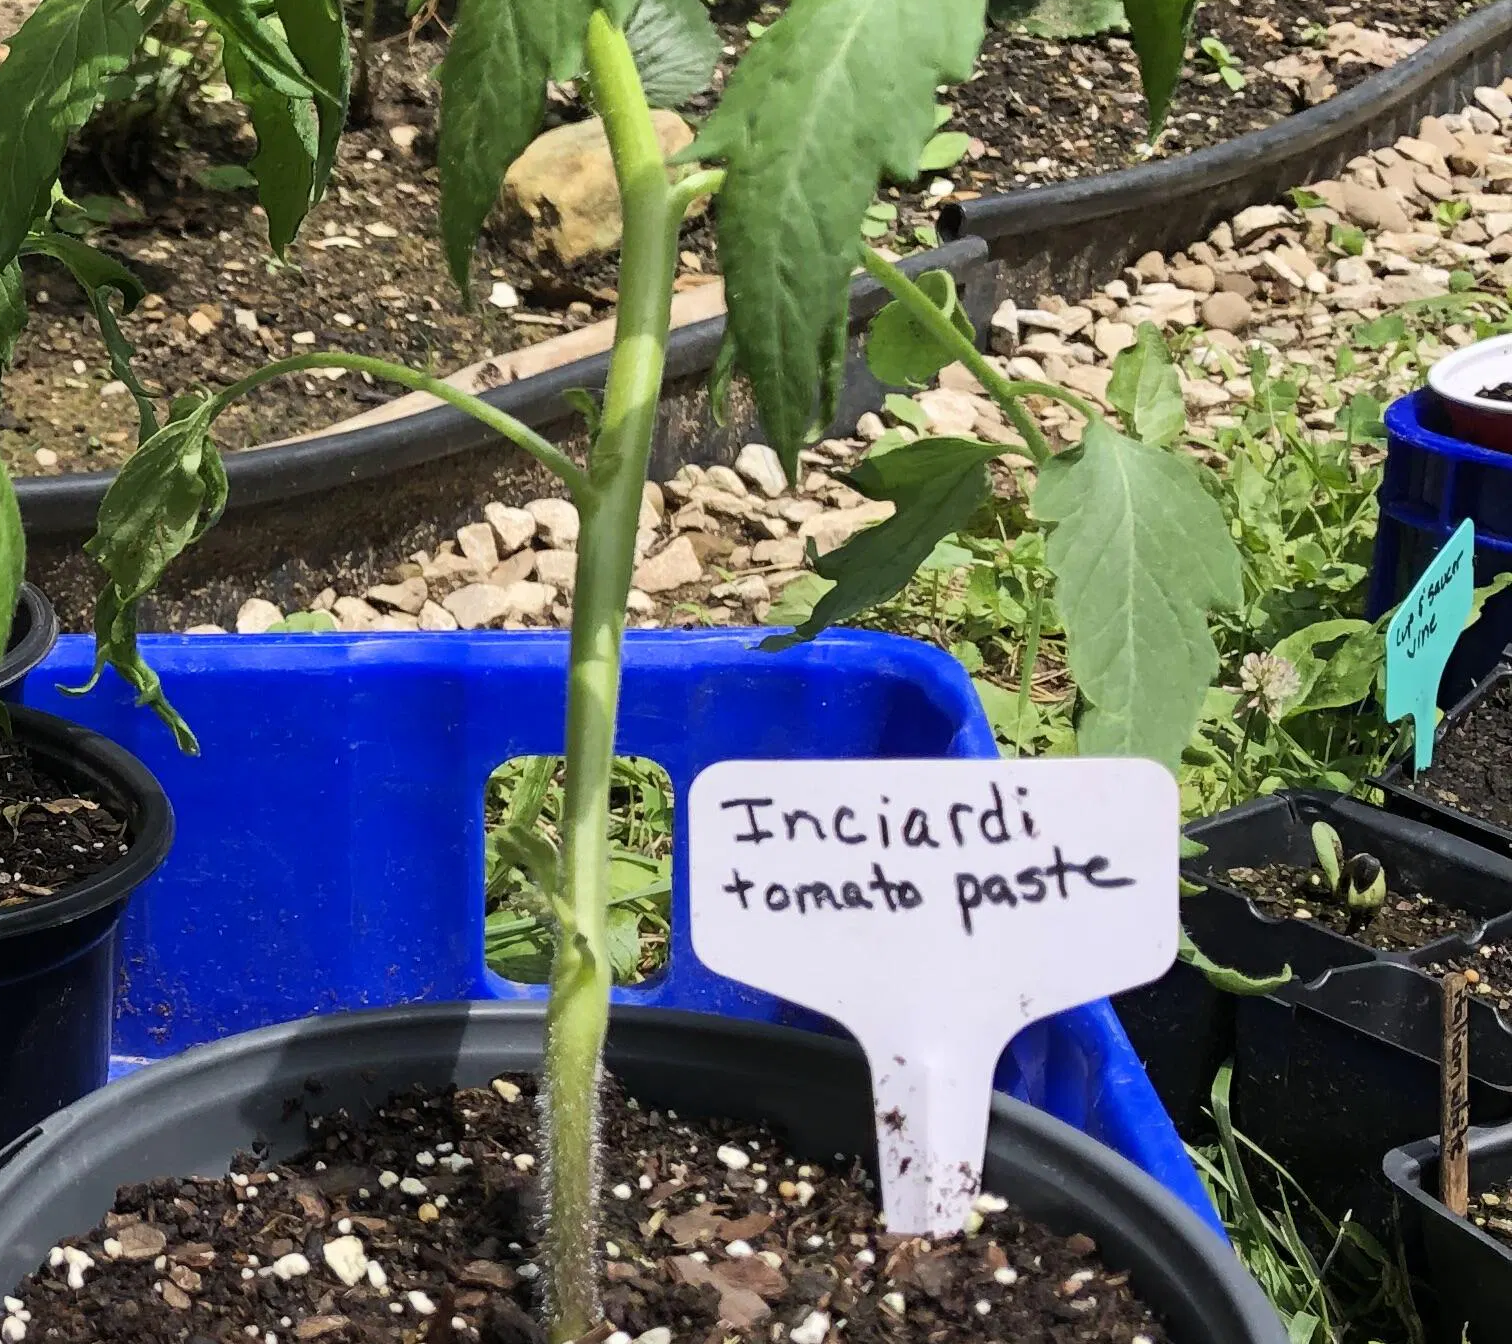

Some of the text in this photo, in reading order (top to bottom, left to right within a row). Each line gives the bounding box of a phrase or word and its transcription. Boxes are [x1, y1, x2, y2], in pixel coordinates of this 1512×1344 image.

[720, 782, 1040, 849] Inciardi
[723, 846, 1136, 935] tomato paste
